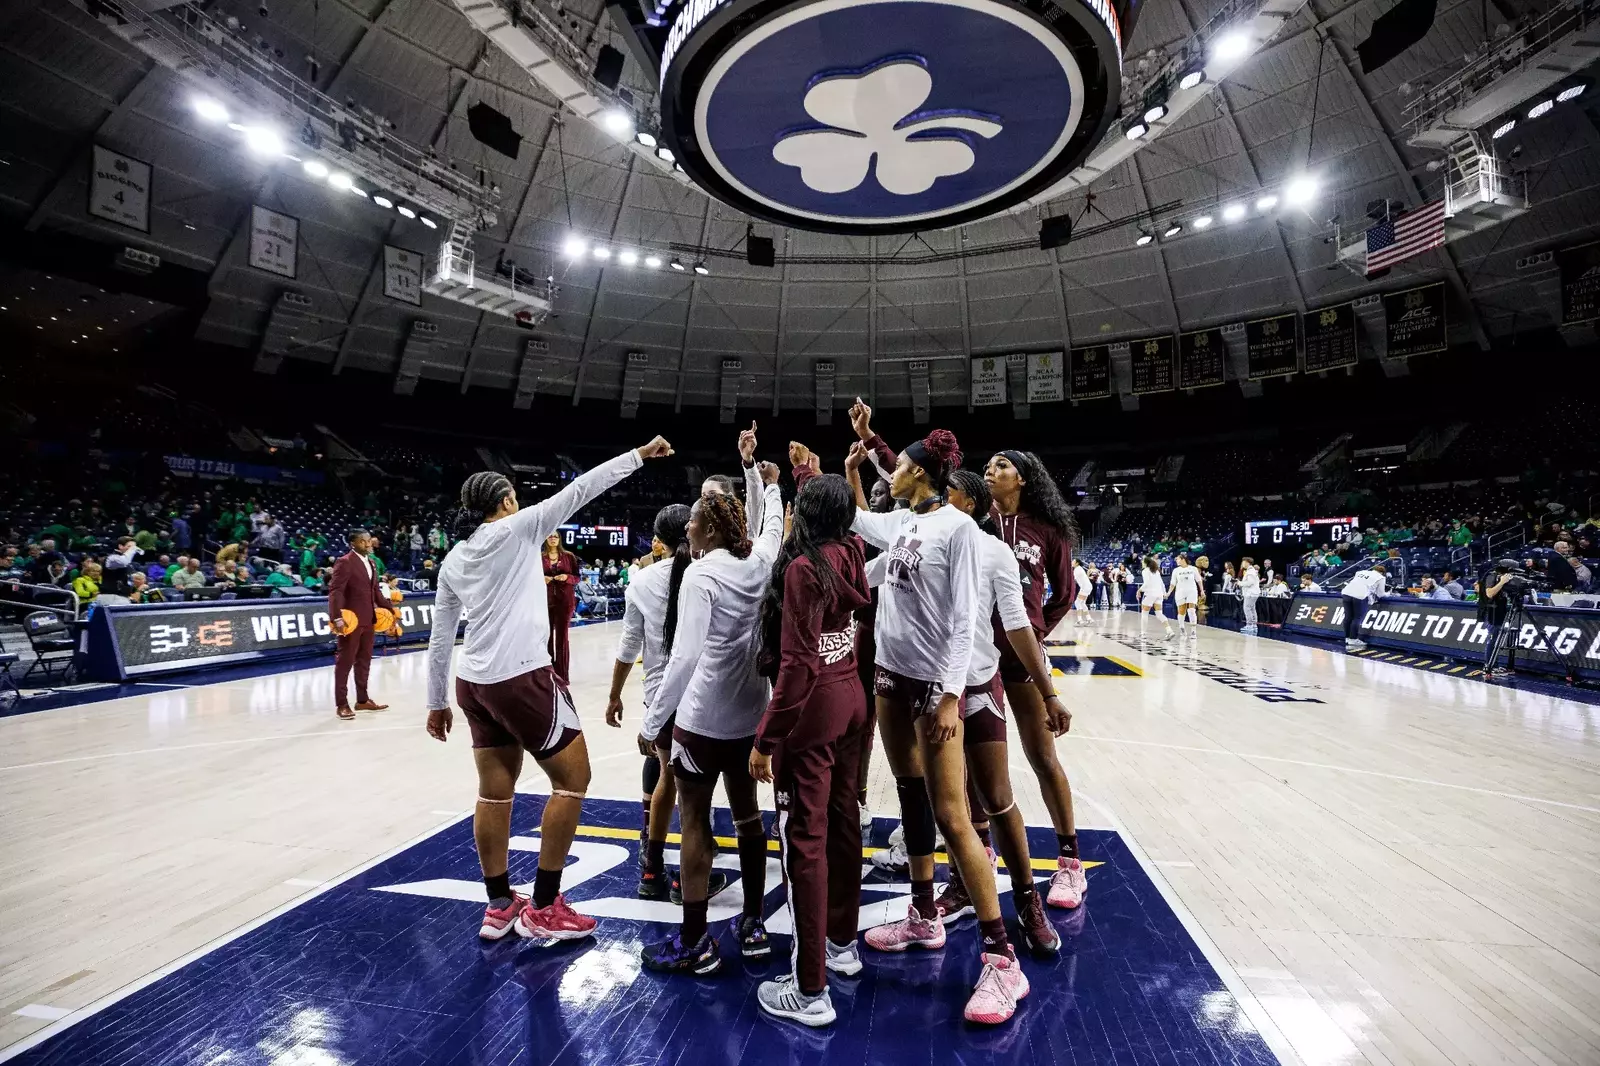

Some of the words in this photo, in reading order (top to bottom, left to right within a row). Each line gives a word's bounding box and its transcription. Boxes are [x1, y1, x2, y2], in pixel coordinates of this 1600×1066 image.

[113, 190, 125, 205] 4
[264, 240, 281, 258] 21
[397, 274, 409, 288] 11
[1397, 306, 1433, 322] ACC
[1249, 339, 1294, 350] TOURNAMENT
[1028, 373, 1063, 381] CHAMPION
[199, 460, 213, 471] IT
[215, 461, 236, 475] ALL
[1290, 522, 1310, 531] 16:30
[1332, 525, 1342, 541] 0
[566, 531, 575, 544] 0
[610, 532, 618, 545] 0
[1273, 528, 1283, 543] 0
[1421, 614, 1454, 639] TO
[1516, 623, 1582, 655] BIG
